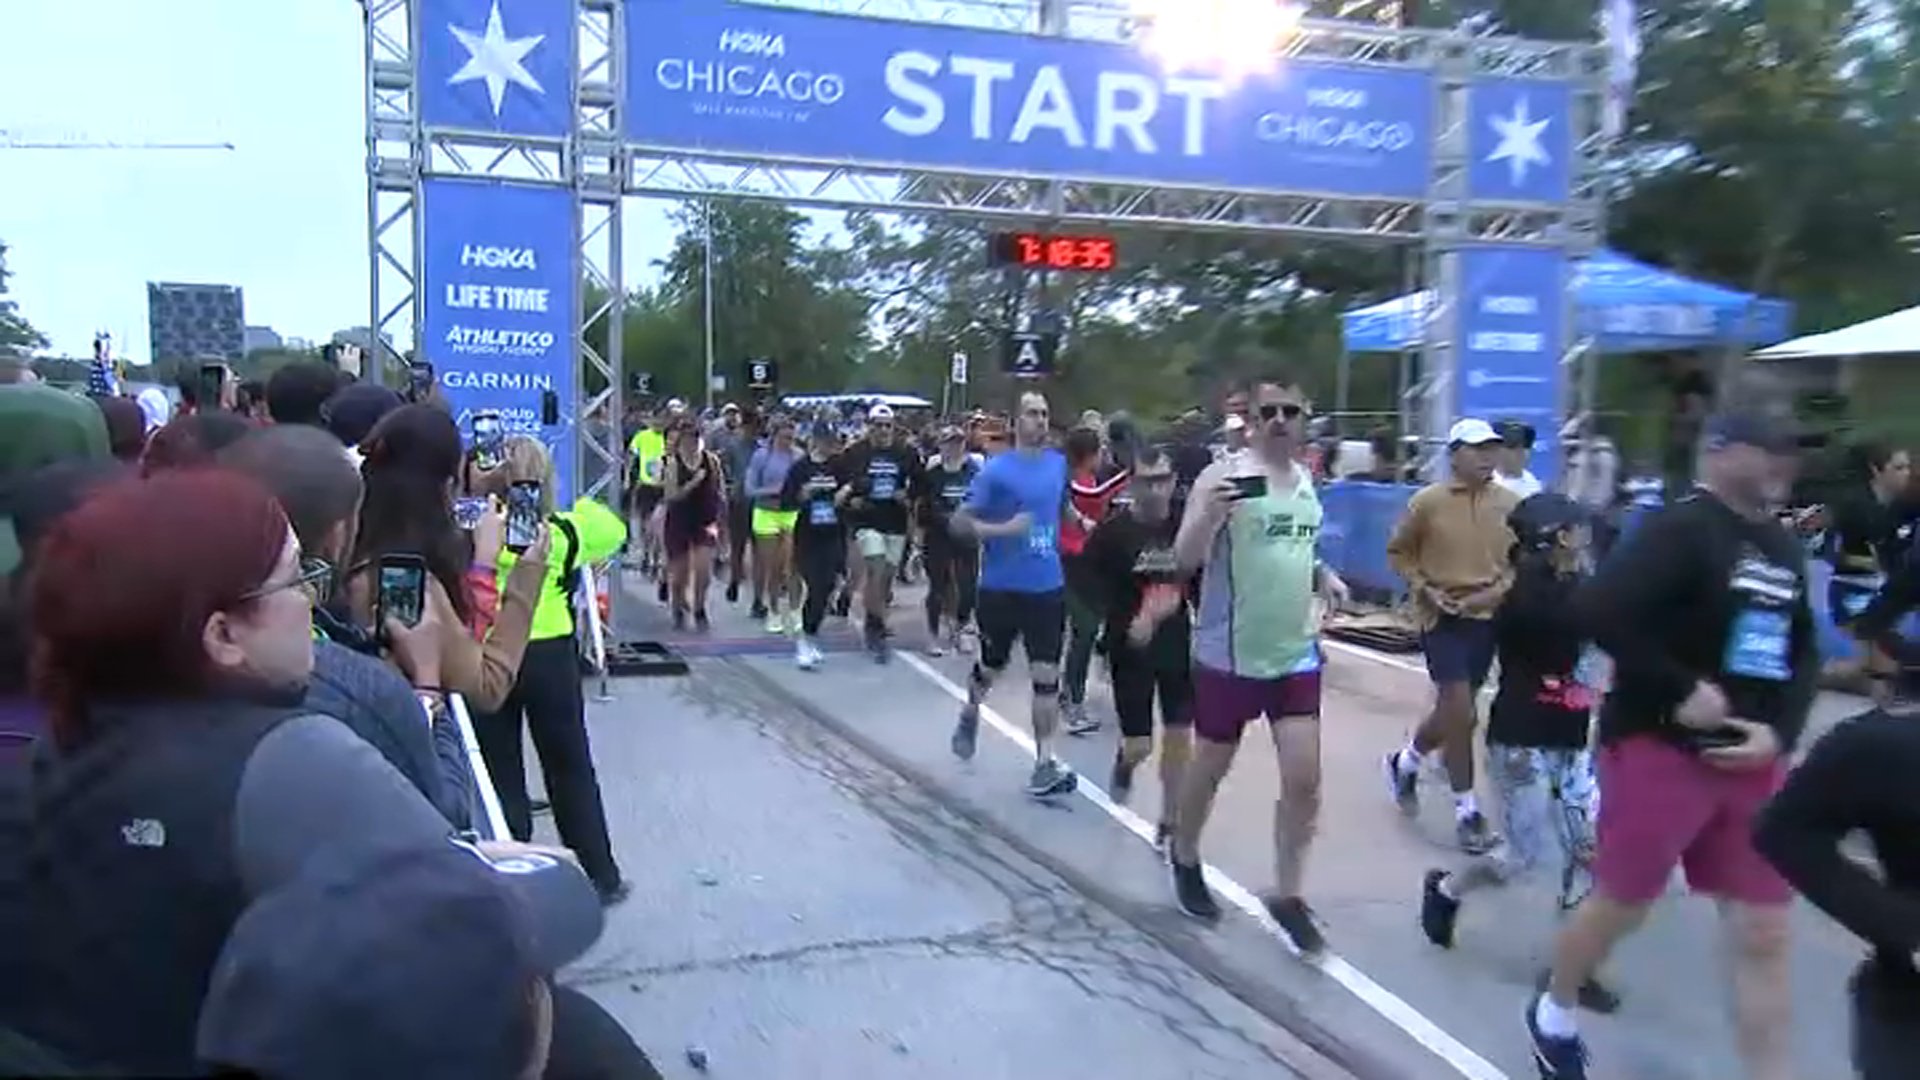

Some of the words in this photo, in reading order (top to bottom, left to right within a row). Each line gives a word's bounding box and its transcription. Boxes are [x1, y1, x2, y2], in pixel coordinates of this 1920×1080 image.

[719, 28, 786, 58] HOKA
[656, 57, 844, 105] CHICAGO
[882, 50, 1226, 156] START
[1257, 111, 1415, 152] CHICAGO
[461, 244, 535, 270] HOKA
[446, 325, 554, 347] ATHLETICO
[1016, 341, 1040, 364] A
[443, 371, 551, 391] GARMIN
